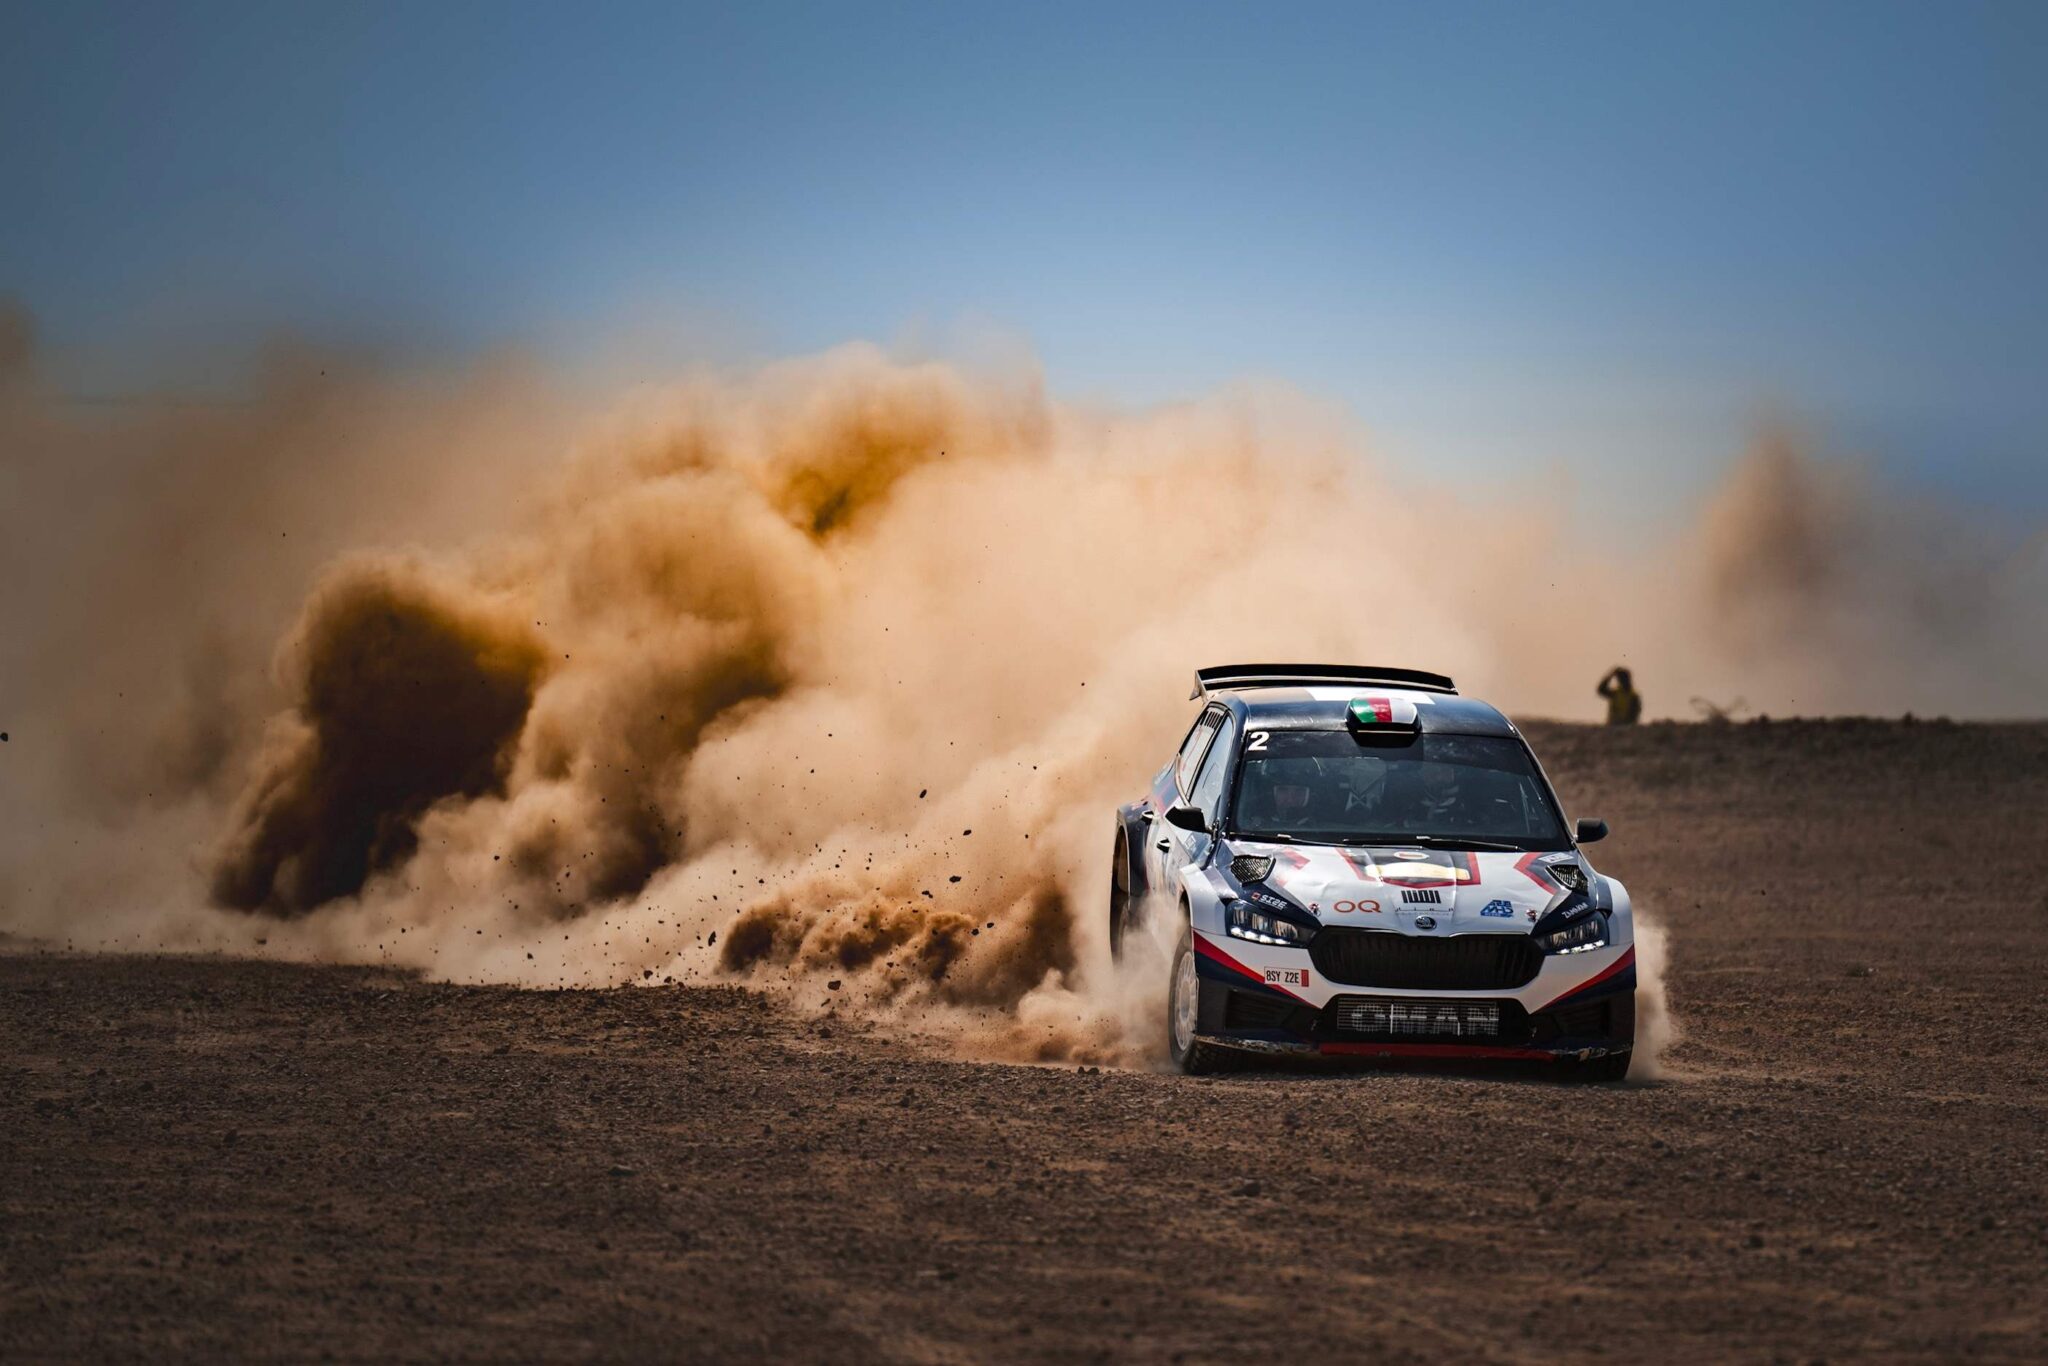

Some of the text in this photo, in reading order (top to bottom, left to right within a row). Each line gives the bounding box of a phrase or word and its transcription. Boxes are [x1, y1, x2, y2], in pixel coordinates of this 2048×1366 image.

[1247, 731, 1270, 751] 2
[1333, 899, 1382, 913] OQ
[1351, 1004, 1499, 1036] OMAN
